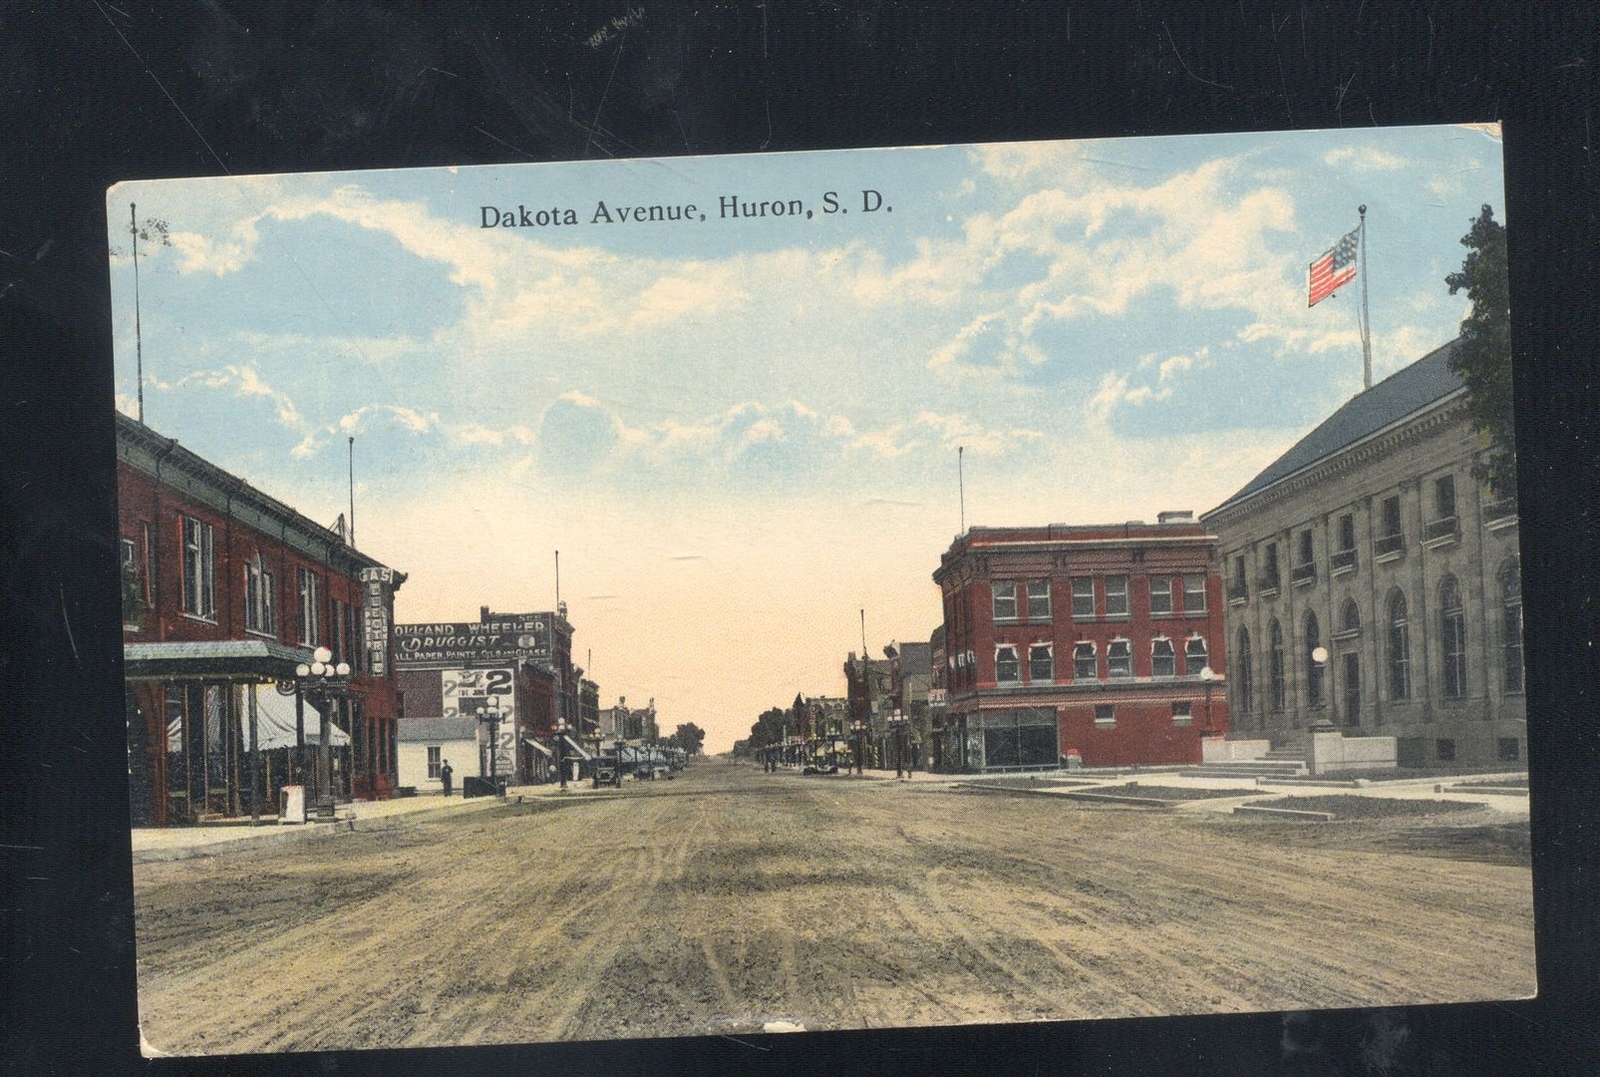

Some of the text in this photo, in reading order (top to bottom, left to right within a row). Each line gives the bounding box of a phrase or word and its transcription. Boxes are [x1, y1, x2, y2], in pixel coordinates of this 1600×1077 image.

[359, 567, 390, 581] GAS
[394, 621, 544, 636] OLLAND WHEELER
[401, 635, 500, 652] DRUGGIST
[486, 670, 512, 695] 2
